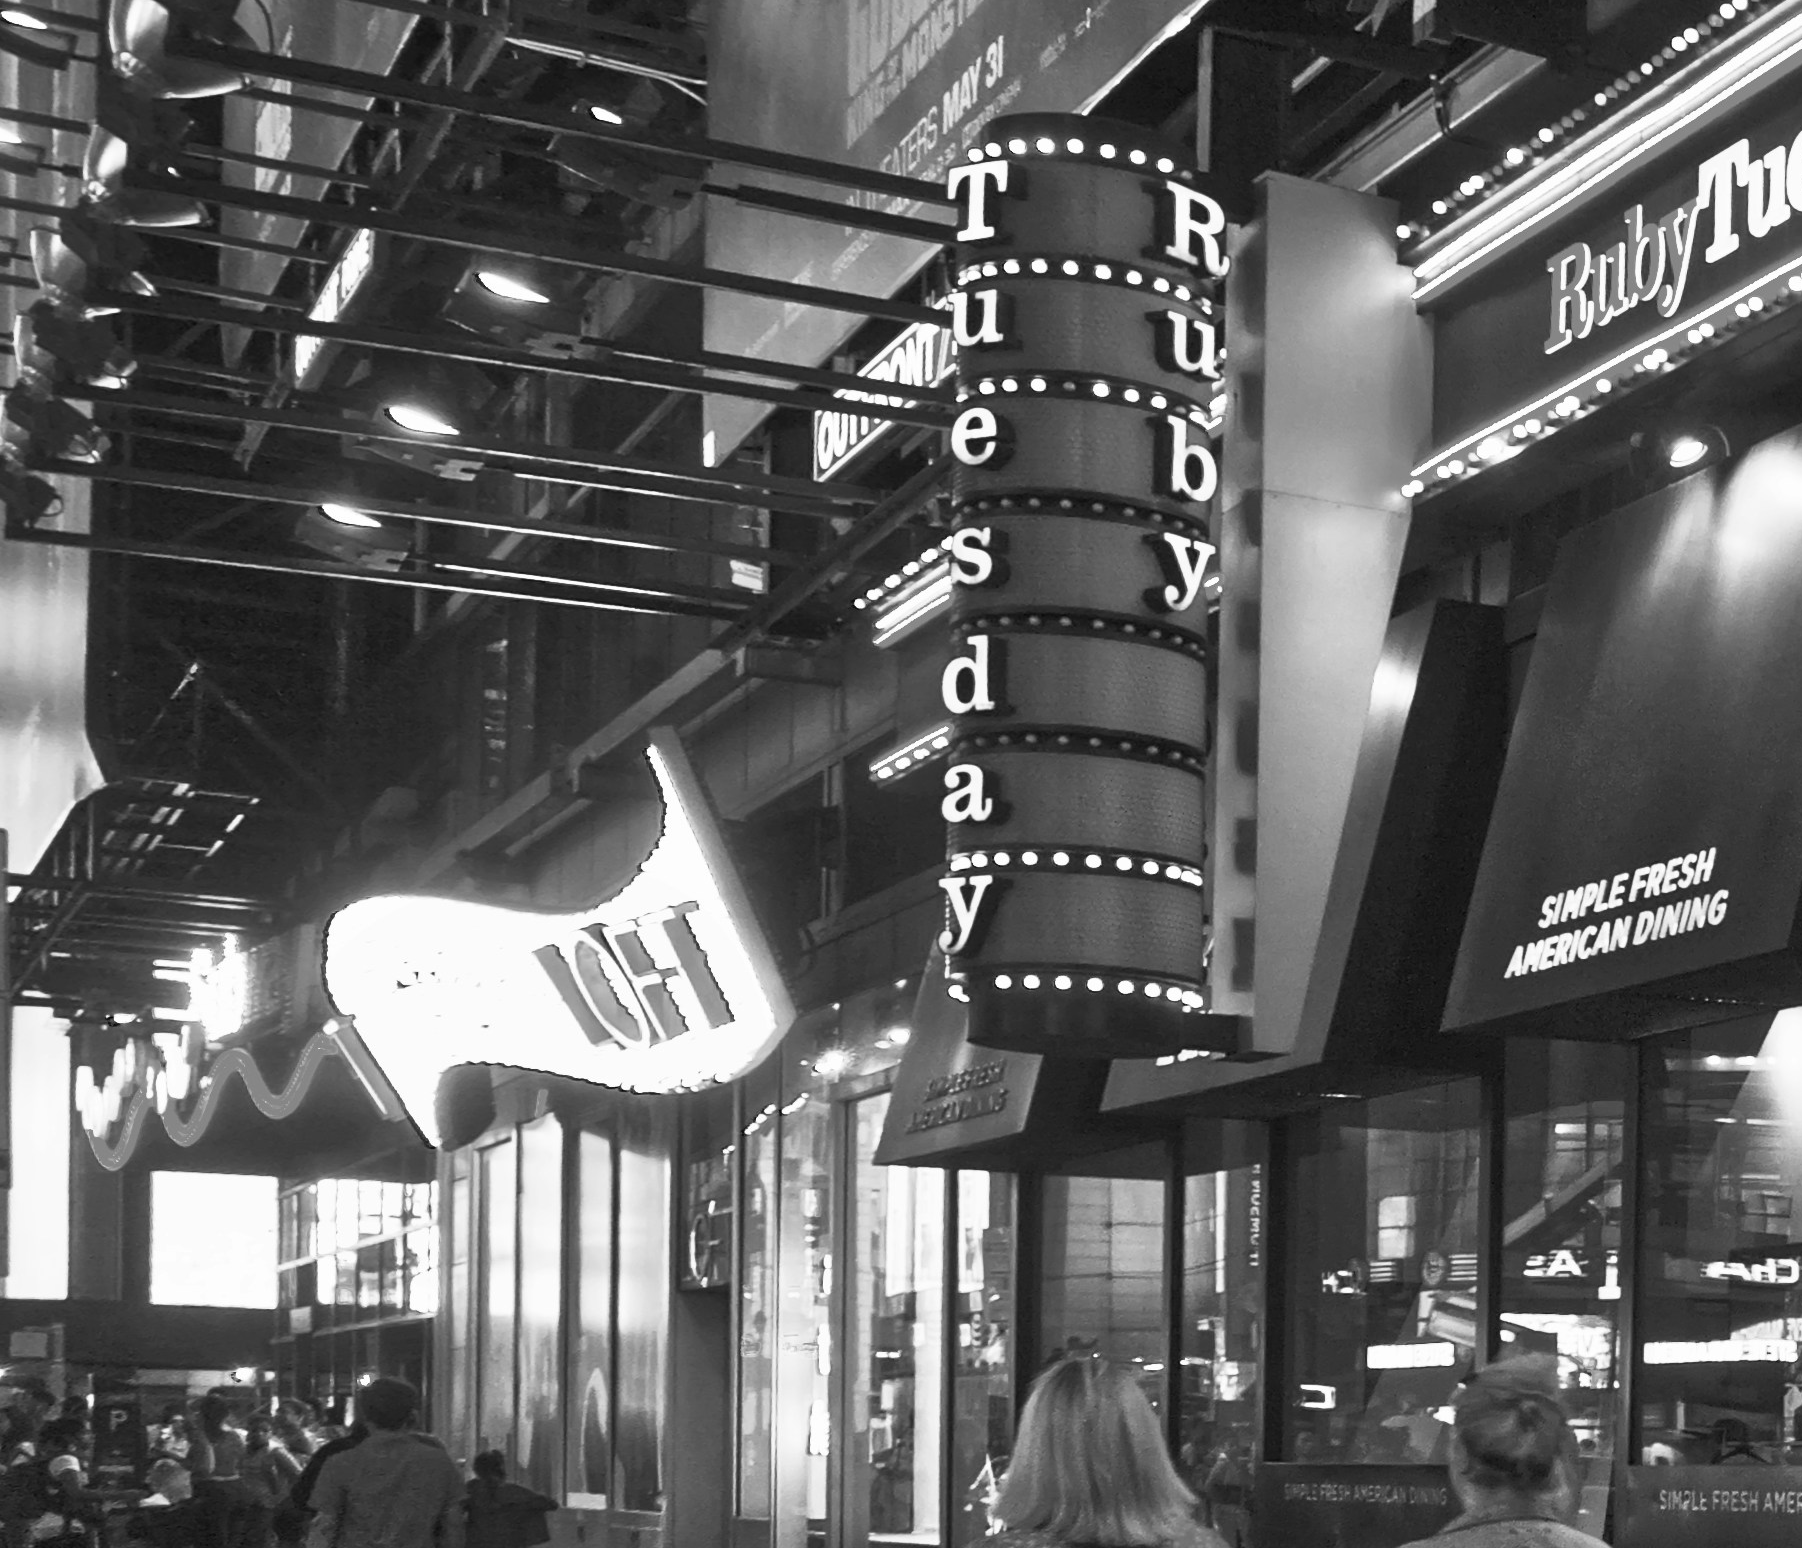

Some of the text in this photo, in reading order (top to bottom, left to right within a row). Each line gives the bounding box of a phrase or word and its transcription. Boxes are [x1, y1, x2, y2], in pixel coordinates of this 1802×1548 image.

[942, 56, 983, 134] MAY
[985, 35, 1004, 88] 31
[1163, 180, 1231, 612] Ruby
[938, 159, 1010, 955] Tuesday
[1503, 889, 1729, 979] AMERICAN DINING
[1538, 847, 1717, 929] SIMPLE FRESH
[1659, 1489, 1708, 1511] SIMPLE
[1711, 1489, 1760, 1512] FRESH
